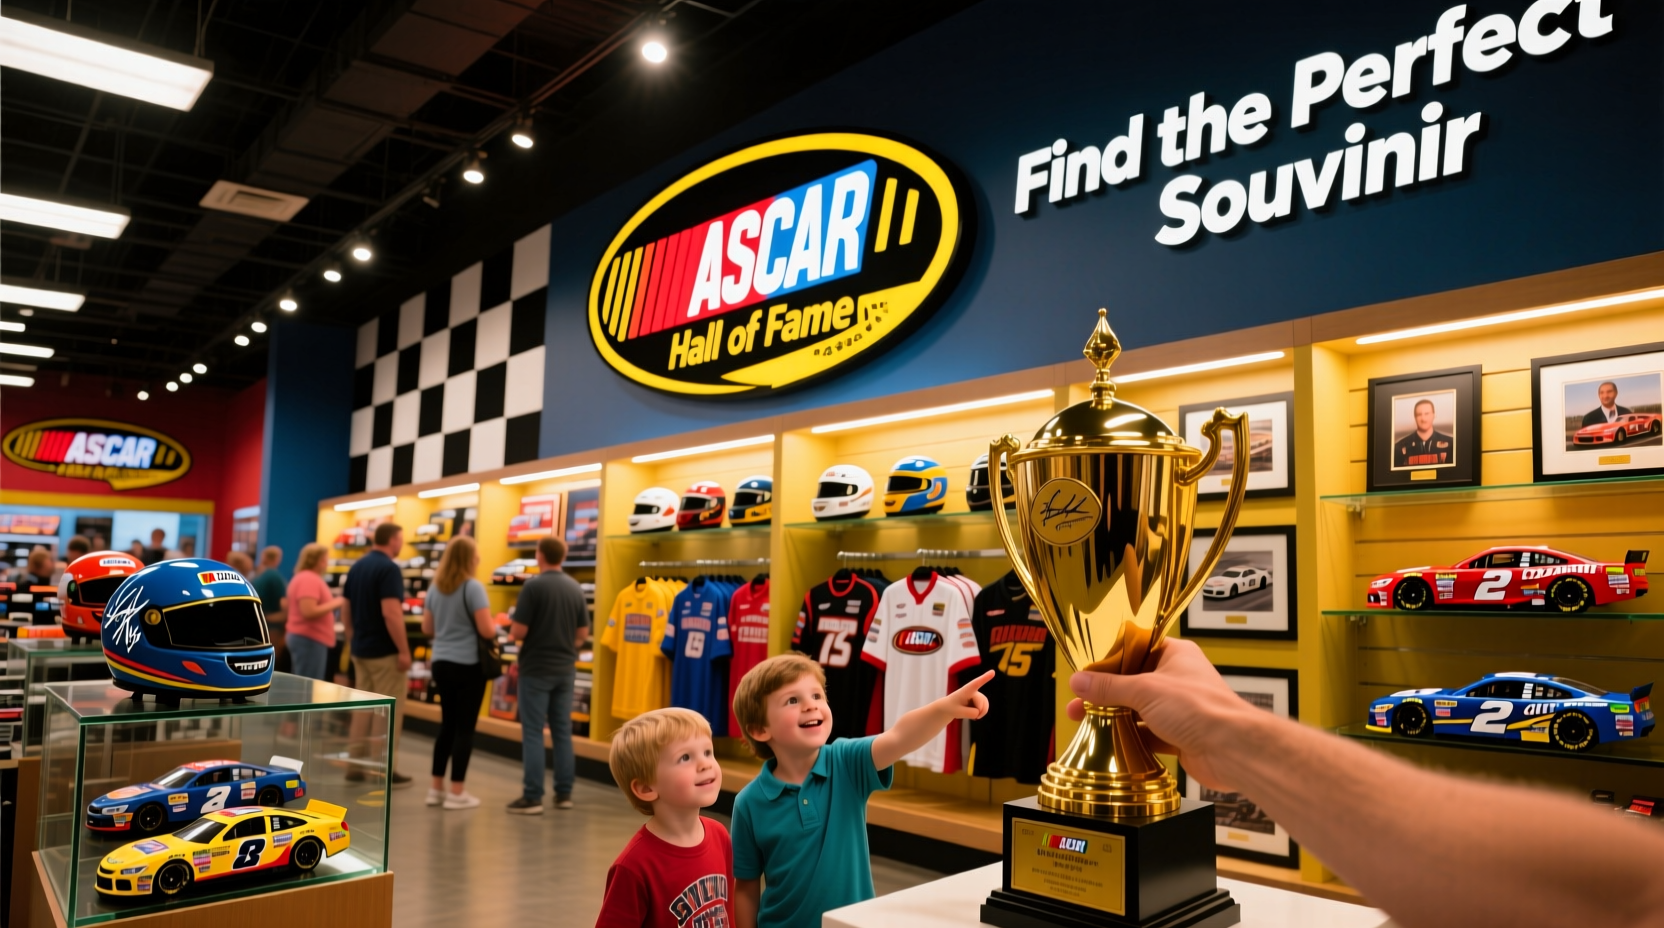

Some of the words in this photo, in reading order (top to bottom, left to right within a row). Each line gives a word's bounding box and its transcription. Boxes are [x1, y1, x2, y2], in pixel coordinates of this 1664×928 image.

[1014, 113, 1143, 215] Find
[1157, 91, 1271, 168] the
[1291, 0, 1614, 128] Perfect
[1155, 101, 1481, 246] Souvinir
[687, 170, 869, 317] ASCAR
[668, 320, 723, 370] Hall
[727, 319, 760, 356] of
[763, 296, 855, 348] Fame
[64, 431, 157, 470] ASCAR
[1474, 570, 1513, 601] 2
[1470, 700, 1514, 734] 2
